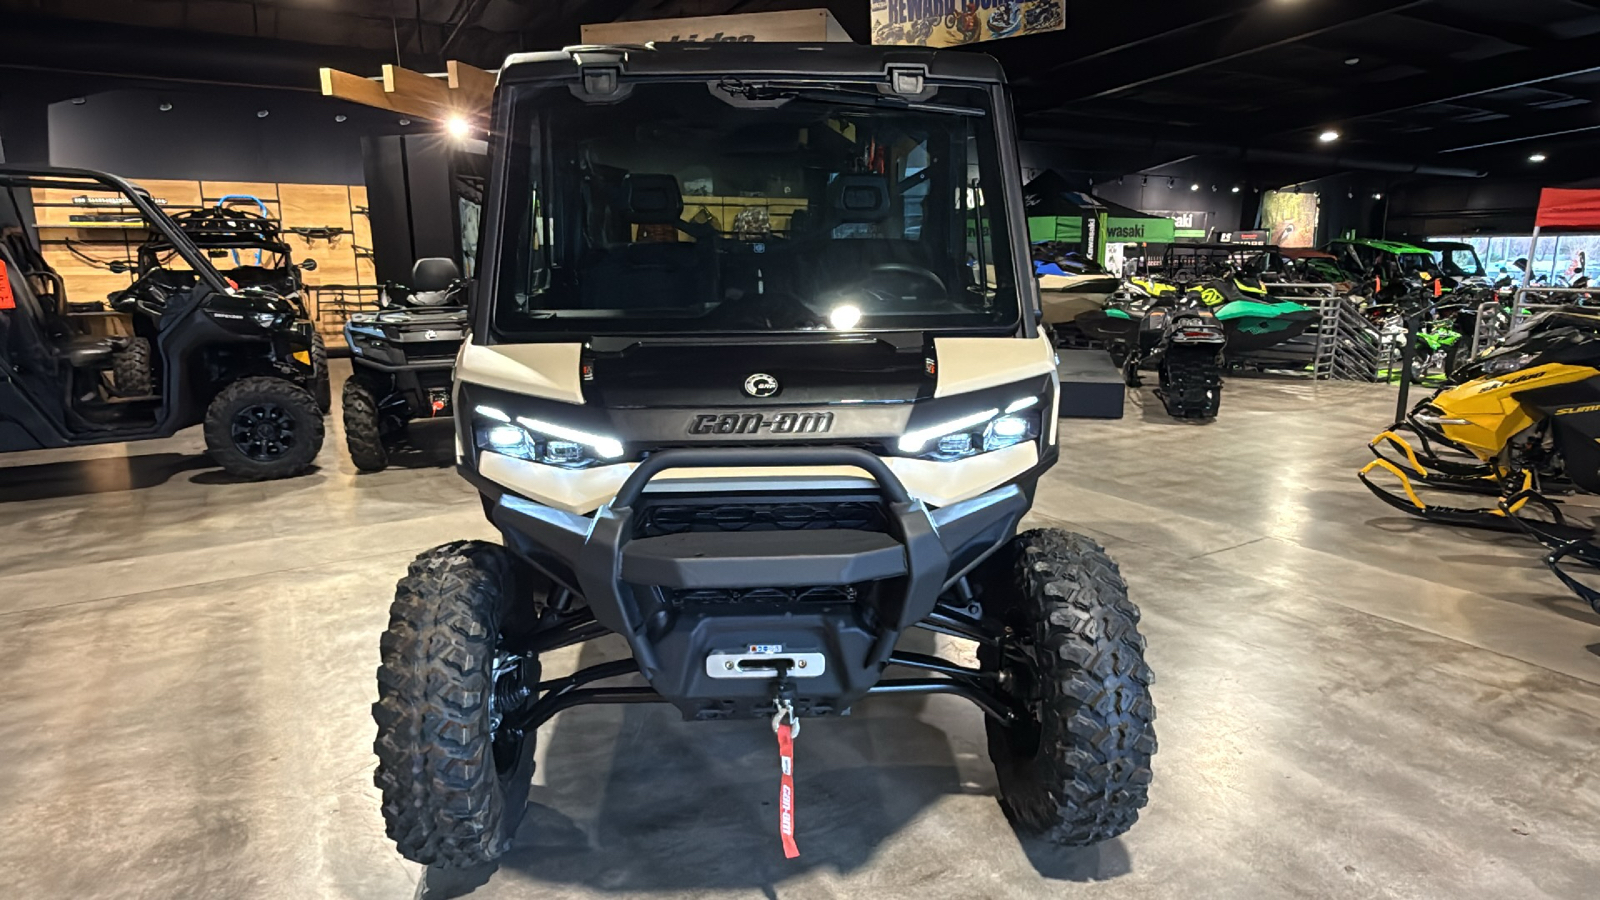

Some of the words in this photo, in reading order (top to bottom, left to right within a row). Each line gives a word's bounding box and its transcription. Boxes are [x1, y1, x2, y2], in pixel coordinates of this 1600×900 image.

[1171, 213, 1193, 228] aki
[1107, 224, 1145, 238] wasaki
[1086, 218, 1096, 260] Kawasaki
